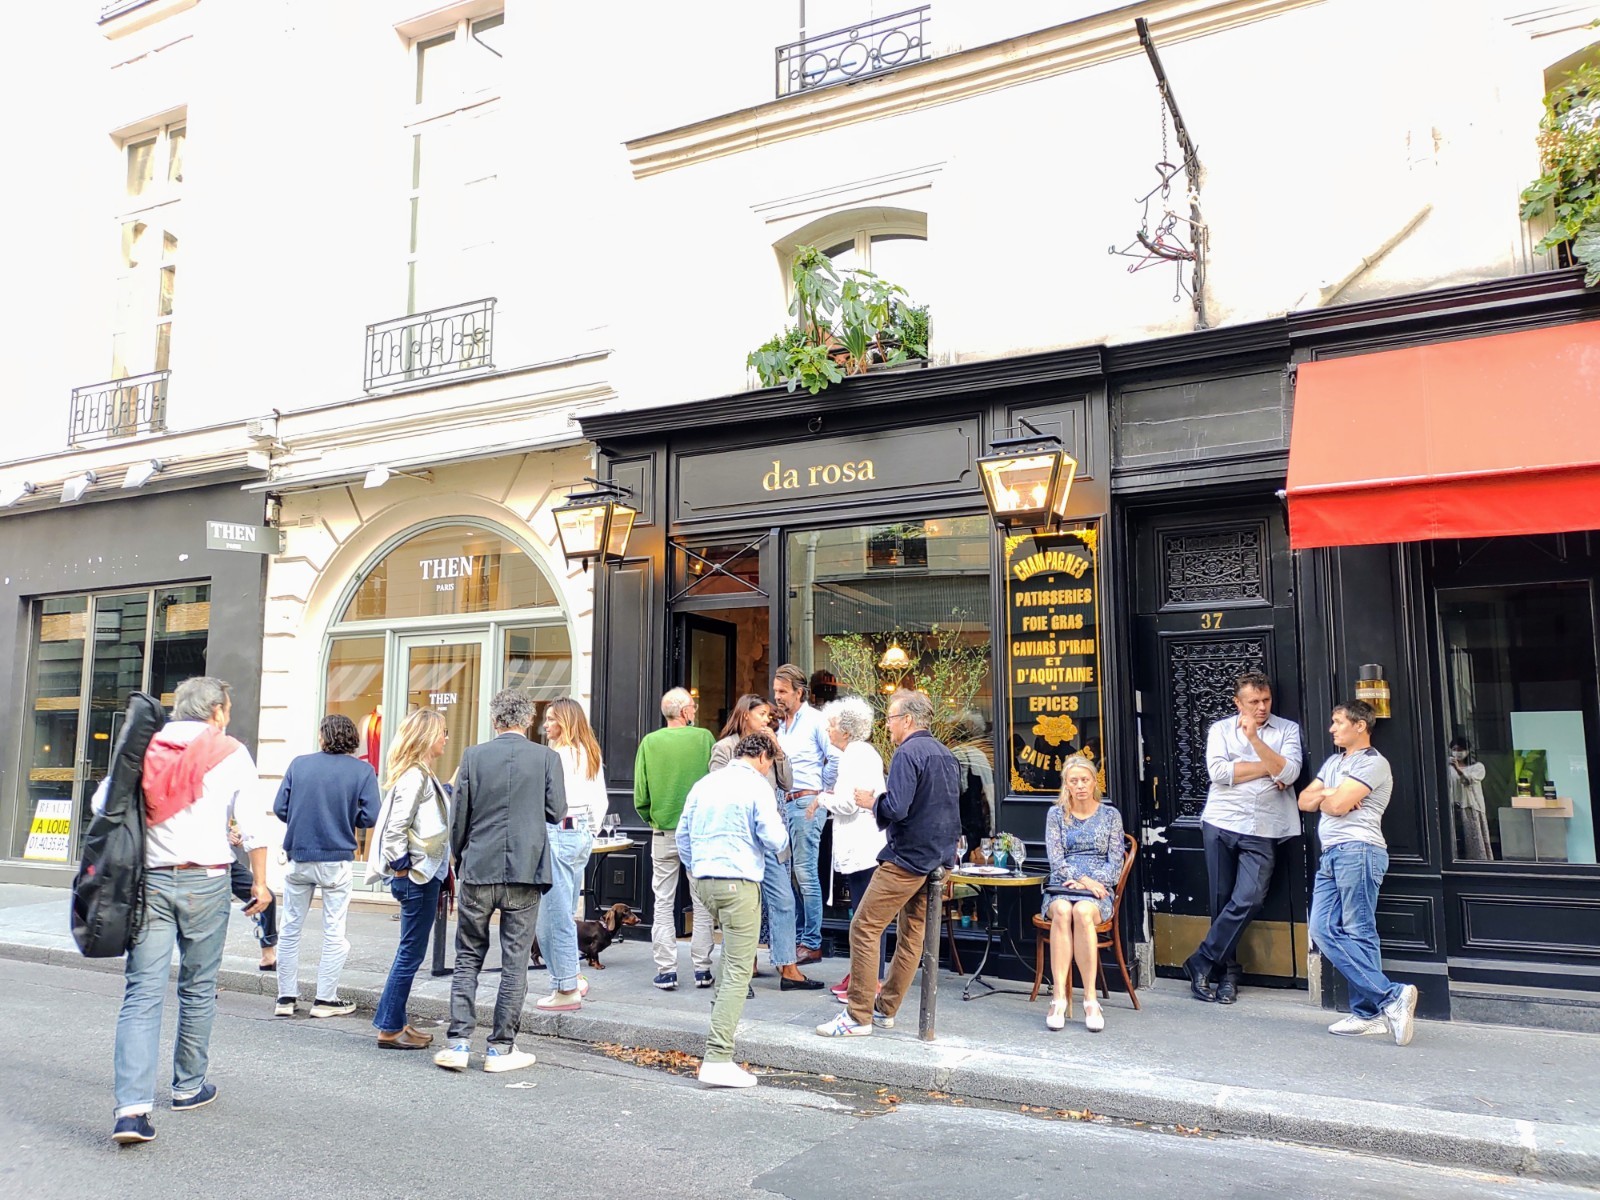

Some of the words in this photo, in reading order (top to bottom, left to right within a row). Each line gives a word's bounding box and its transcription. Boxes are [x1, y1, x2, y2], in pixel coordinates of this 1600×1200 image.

[762, 460, 800, 491] da
[807, 459, 876, 487] rosa
[210, 522, 256, 542] THEN
[419, 555, 474, 580] THEN
[1013, 551, 1089, 582] CHAMPAGNES
[435, 583, 455, 592] PARIS
[1015, 588, 1092, 607] PATISSERIES
[1022, 615, 1048, 632] FOIE
[1051, 613, 1083, 631] GRAS
[1201, 612, 1223, 630] 37
[1012, 640, 1056, 656] CAVIARS
[1058, 638, 1095, 655] D'IRAN
[1045, 656, 1062, 666] ET
[1016, 666, 1094, 685] D'AQUITAINE
[429, 692, 457, 705] THEN
[1029, 695, 1079, 712] EPICES
[1021, 745, 1051, 771] CAVE
[35, 819, 43, 833] A
